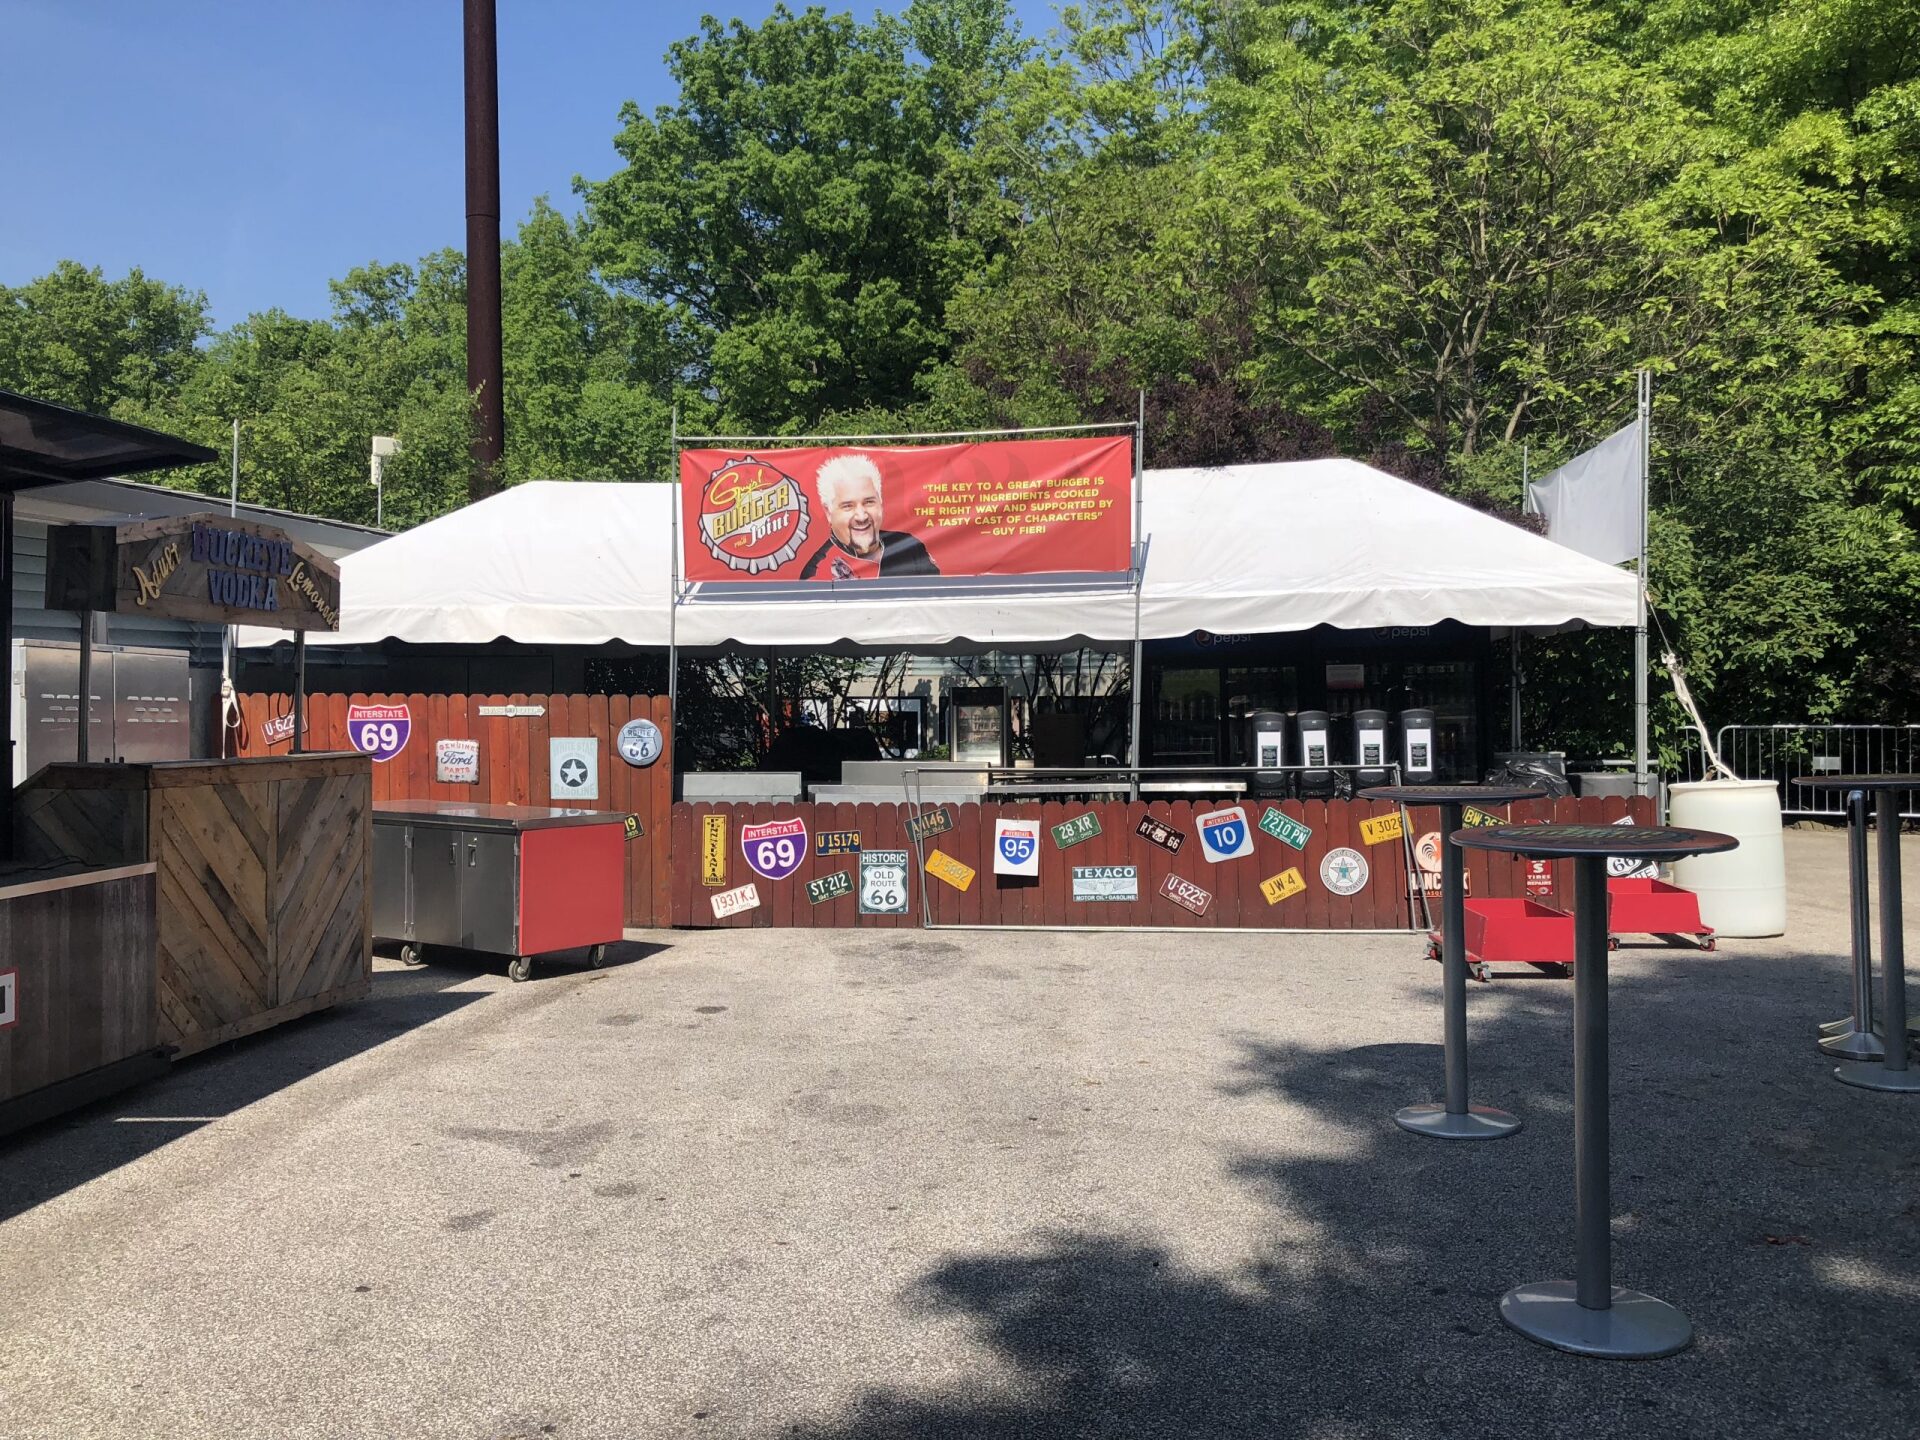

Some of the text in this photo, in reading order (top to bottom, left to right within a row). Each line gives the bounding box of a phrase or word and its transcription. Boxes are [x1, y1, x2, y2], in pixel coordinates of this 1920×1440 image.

[952, 483, 972, 492] KEY
[977, 482, 991, 491] TO
[996, 482, 1003, 490] A
[1008, 480, 1042, 490] GREAT
[1047, 478, 1090, 488] BURGER
[1094, 477, 1104, 486] IS
[928, 489, 1099, 504] QUALITY INGREDIENTS COOKED
[712, 484, 790, 541] BURGER
[914, 500, 1113, 516] THE RIGHT WAY AND SUPPORTED BY
[938, 518, 970, 527] TASTY
[975, 516, 1002, 525] CAST
[1006, 515, 1022, 524] OF
[746, 511, 790, 547] Joint
[1019, 526, 1046, 535] FIERI
[191, 522, 293, 576] BUCKEYE
[132, 542, 180, 606] Adult
[207, 569, 279, 612] VODKA
[287, 561, 340, 631] Lemonade
[1213, 634, 1251, 646] pepsi
[1391, 627, 1430, 639] pepsi
[354, 709, 404, 718] INTERSTATE
[361, 723, 398, 751] 69
[628, 729, 651, 737] ROUTE
[439, 743, 476, 751] GENUINE
[630, 742, 650, 758] 66
[440, 750, 474, 765] Ford
[1207, 815, 1235, 825] INTERSTATE
[748, 824, 799, 838] INTERSTATE
[1080, 830, 1093, 839] OHIO
[1264, 814, 1306, 845] 7210 PN
[1367, 824, 1373, 836] V
[818, 834, 859, 848] U 15179
[1167, 836, 1180, 849] 66
[1213, 827, 1237, 848] 10
[757, 839, 795, 870] 69
[1005, 839, 1030, 858] 95
[862, 853, 906, 863] HISTORIC
[1613, 858, 1636, 872] 66
[874, 871, 894, 879] OLD
[1075, 868, 1134, 878] TEXACO
[832, 888, 845, 897] OHIO
[871, 889, 898, 905] 66
[1169, 892, 1182, 903] OHIO
[1273, 892, 1287, 902] OHIO
